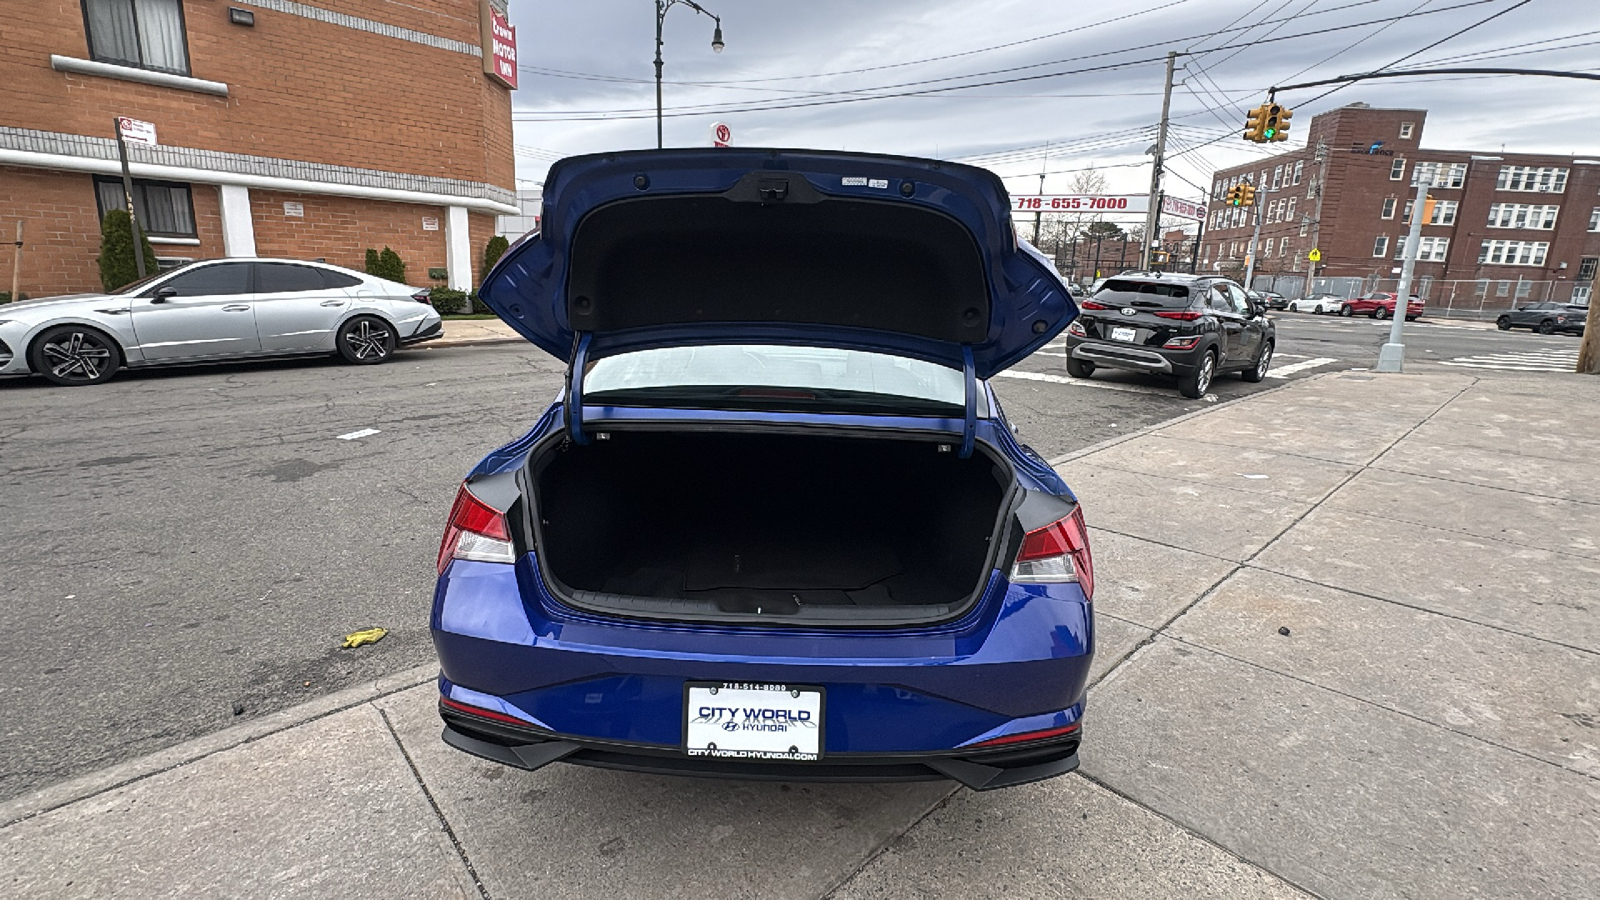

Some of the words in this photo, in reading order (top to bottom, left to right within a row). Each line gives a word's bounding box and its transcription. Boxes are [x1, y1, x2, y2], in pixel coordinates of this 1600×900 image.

[492, 38, 516, 61] MOTOR
[499, 59, 513, 77] INN
[699, 706, 740, 718] CITY
[743, 708, 811, 721] WORLD
[742, 724, 788, 733] HYUNDAI
